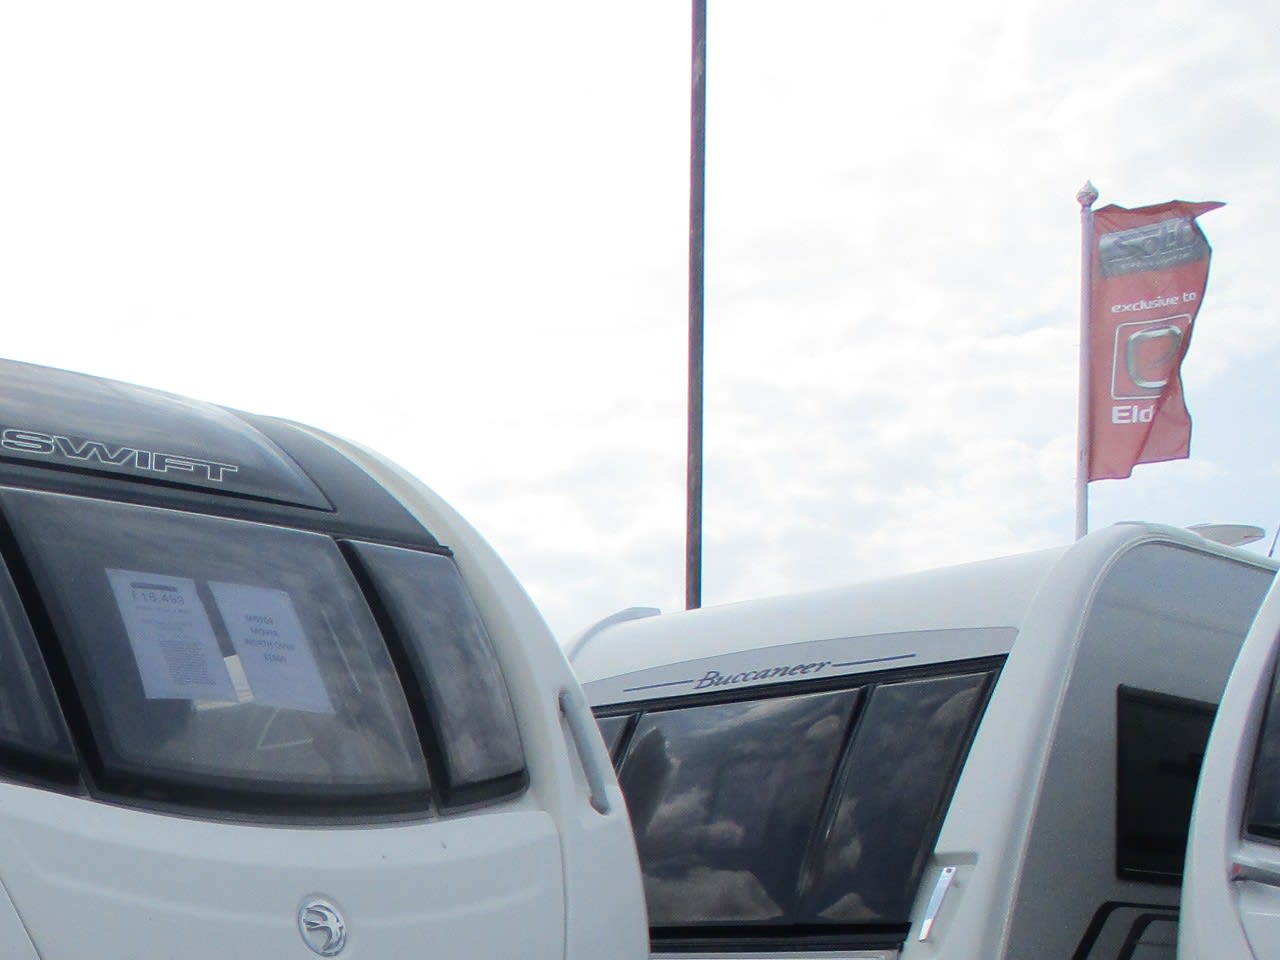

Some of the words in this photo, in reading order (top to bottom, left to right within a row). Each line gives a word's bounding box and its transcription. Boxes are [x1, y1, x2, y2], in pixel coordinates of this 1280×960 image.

[1111, 296, 1180, 313] exclusive
[1182, 292, 1197, 303] to
[1, 428, 239, 482] SWIFT
[693, 661, 832, 690] Buccaneer
